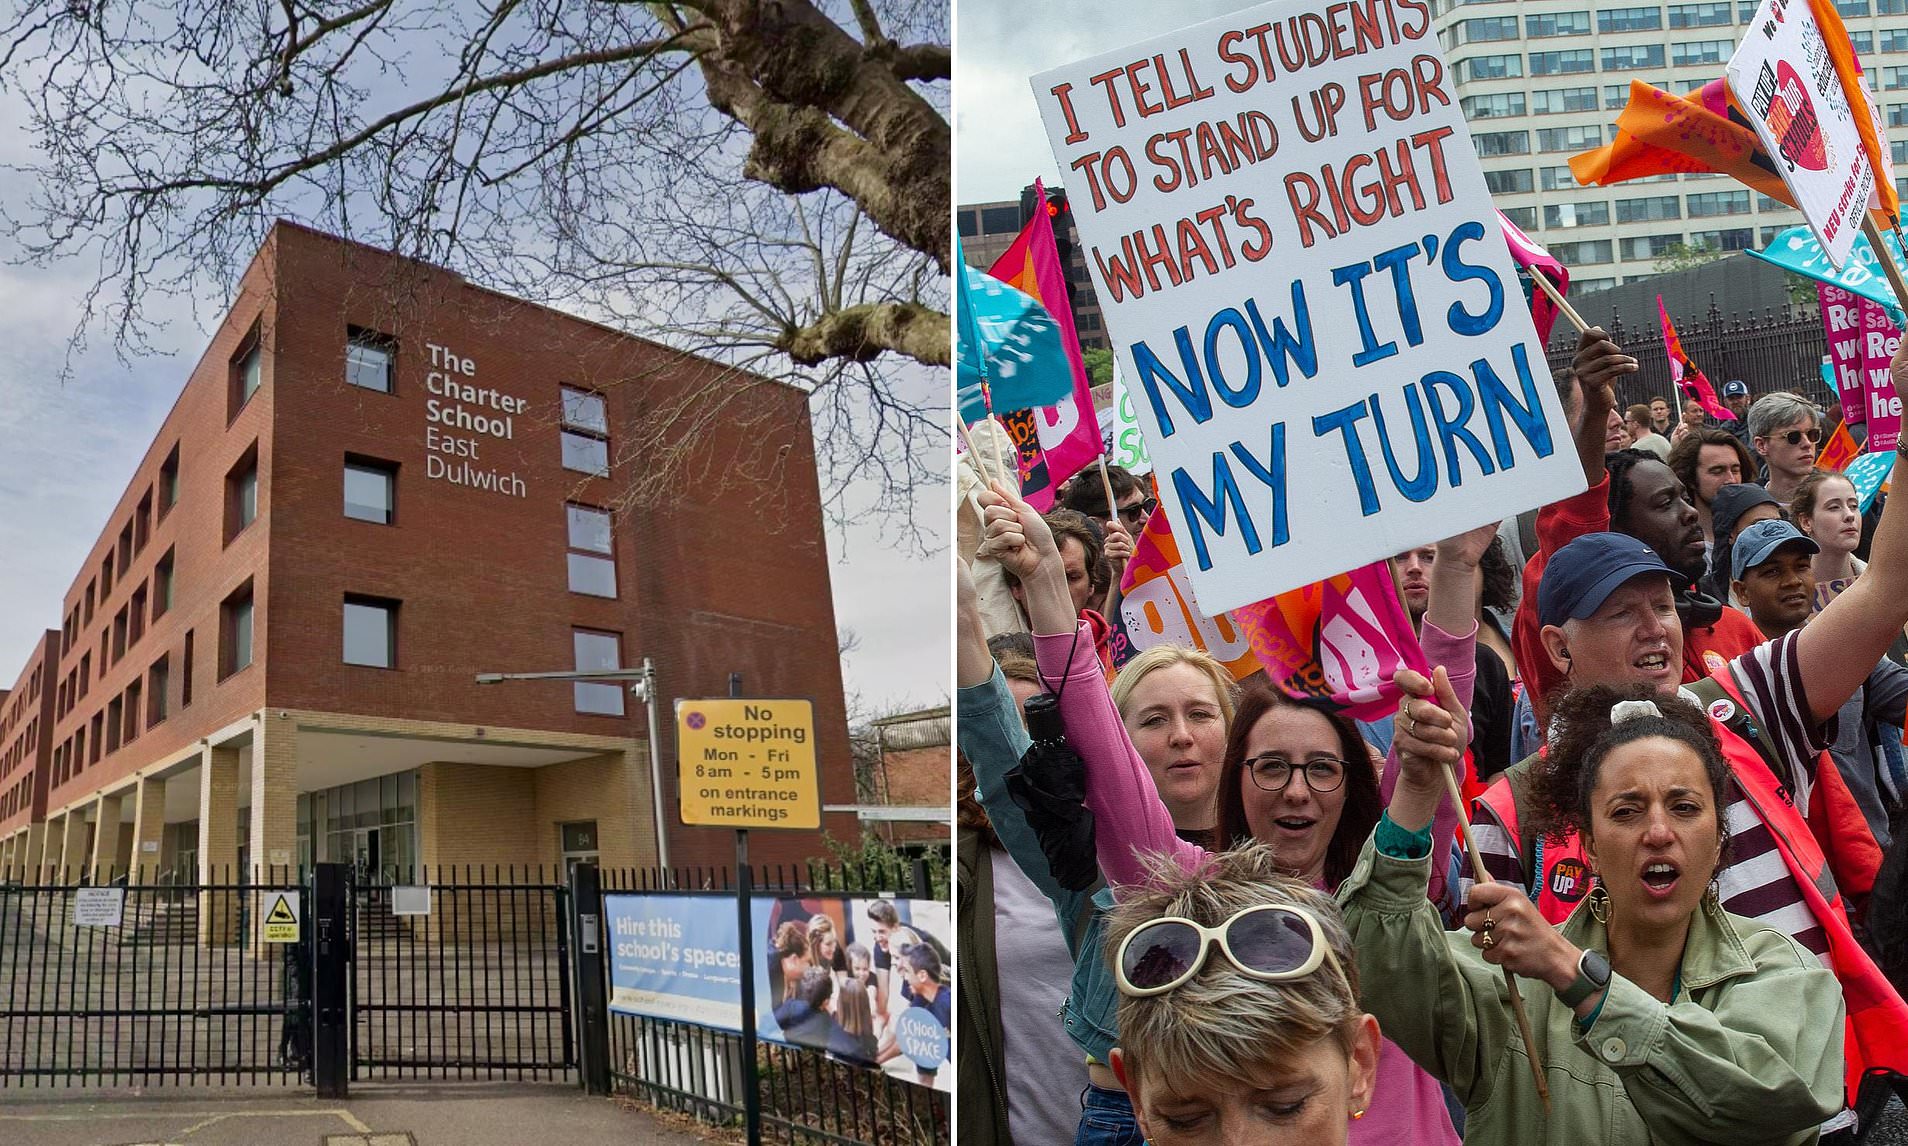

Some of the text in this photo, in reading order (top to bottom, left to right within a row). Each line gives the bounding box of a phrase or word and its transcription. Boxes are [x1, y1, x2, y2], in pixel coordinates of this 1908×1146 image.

[1762, 20, 1777, 40] We
[1051, 0, 1430, 145] I TELL STUDENTS
[1781, 77, 1804, 117] OUR
[1072, 55, 1450, 212] TO STAND UP FOR
[1778, 99, 1818, 173] SCHOOLS
[1092, 126, 1454, 303] WHAT'S RIGHT
[1823, 208, 1841, 243] NEU
[1837, 175, 1857, 217] strike
[1131, 279, 1318, 438] NOW
[1331, 222, 1505, 367] IT'S
[426, 343, 475, 376] The
[426, 372, 527, 415] Charter
[426, 400, 512, 440] School
[427, 426, 479, 460] East
[1171, 343, 1553, 571] MY TURN
[426, 455, 526, 498] Dulwich
[744, 706, 772, 721] No
[713, 724, 806, 743] stopping
[704, 748, 738, 761] Mon
[768, 749, 790, 762] Fri
[700, 787, 798, 801] on entrance
[711, 804, 788, 821] markings
[1553, 874, 1575, 894] UP
[1556, 863, 1584, 879] PAY
[616, 916, 681, 938] Hire this
[616, 939, 680, 962] school's
[901, 1016, 941, 1040] SCHOOL
[906, 1037, 941, 1060] SPACE
